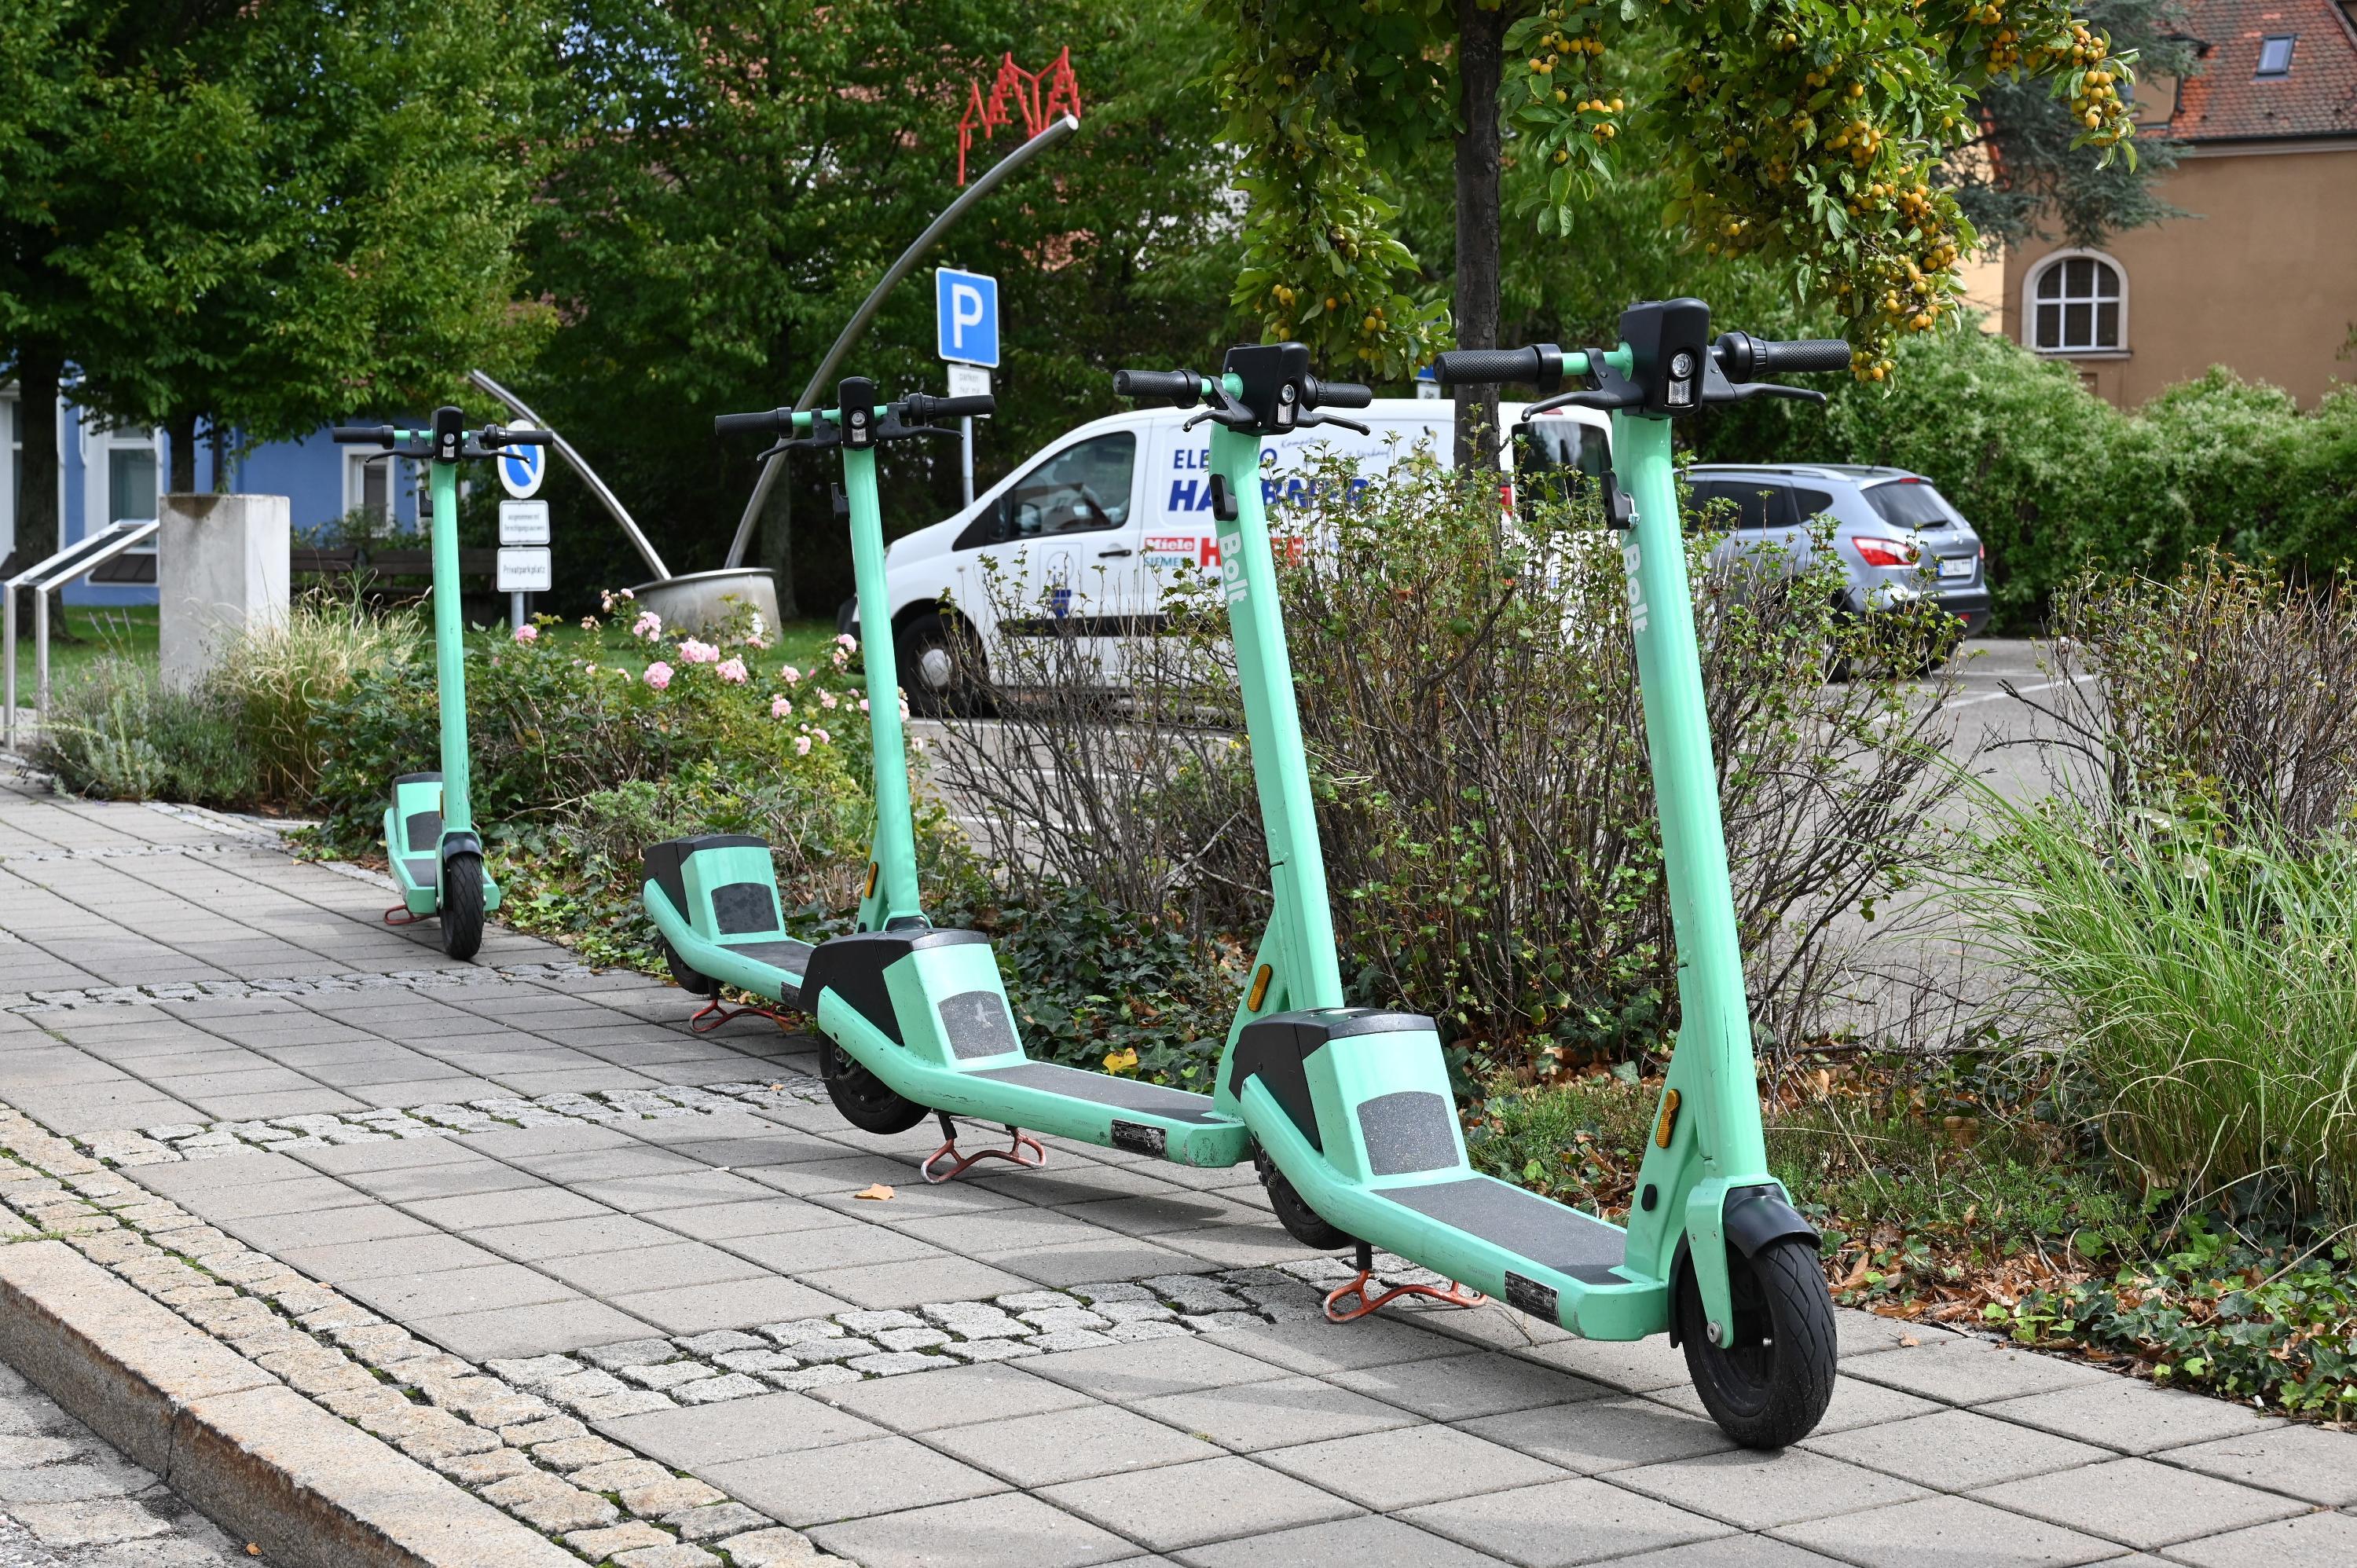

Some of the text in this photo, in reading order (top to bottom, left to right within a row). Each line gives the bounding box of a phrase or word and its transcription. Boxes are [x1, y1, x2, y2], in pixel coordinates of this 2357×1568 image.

[951, 283, 984, 349] P
[1174, 448, 1278, 469] ELEO
[1146, 538, 1193, 550] Miele
[1219, 532, 1248, 605] Bolt
[1622, 544, 1648, 635] Bolt
